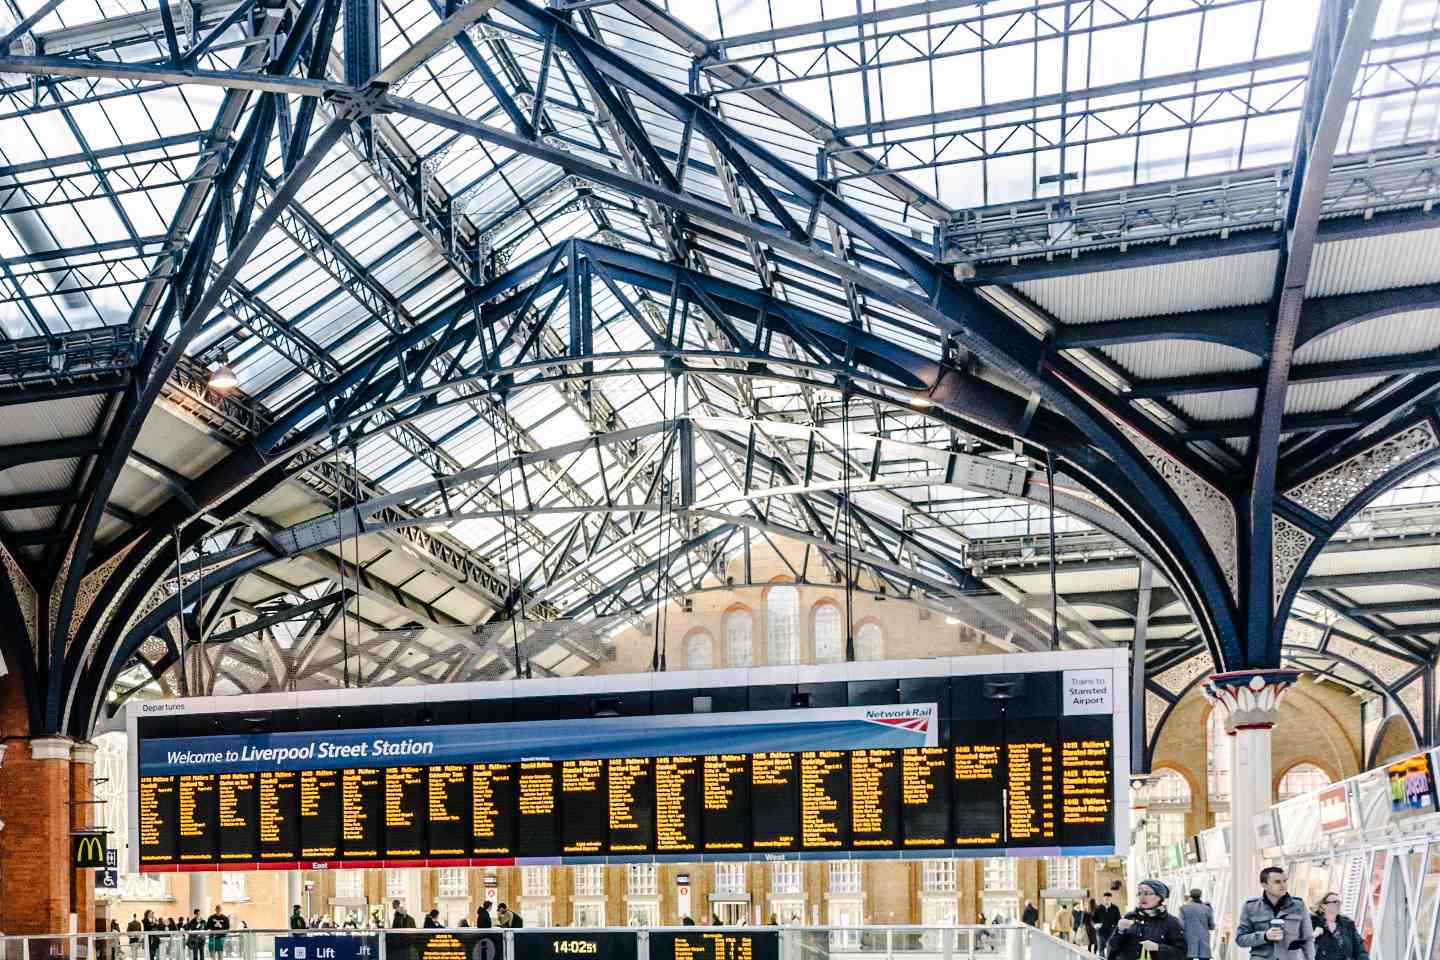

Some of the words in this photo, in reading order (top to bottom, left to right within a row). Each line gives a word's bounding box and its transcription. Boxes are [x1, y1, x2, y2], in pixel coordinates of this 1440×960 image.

[1069, 687, 1107, 696] Stansted
[1073, 697, 1104, 706] Airport
[142, 702, 185, 713] Departures
[167, 750, 222, 765] Welcome
[224, 750, 239, 762] to
[241, 742, 315, 764] Liverpool
[318, 741, 367, 759] Street
[372, 739, 433, 757] Station
[316, 947, 336, 959] Lift
